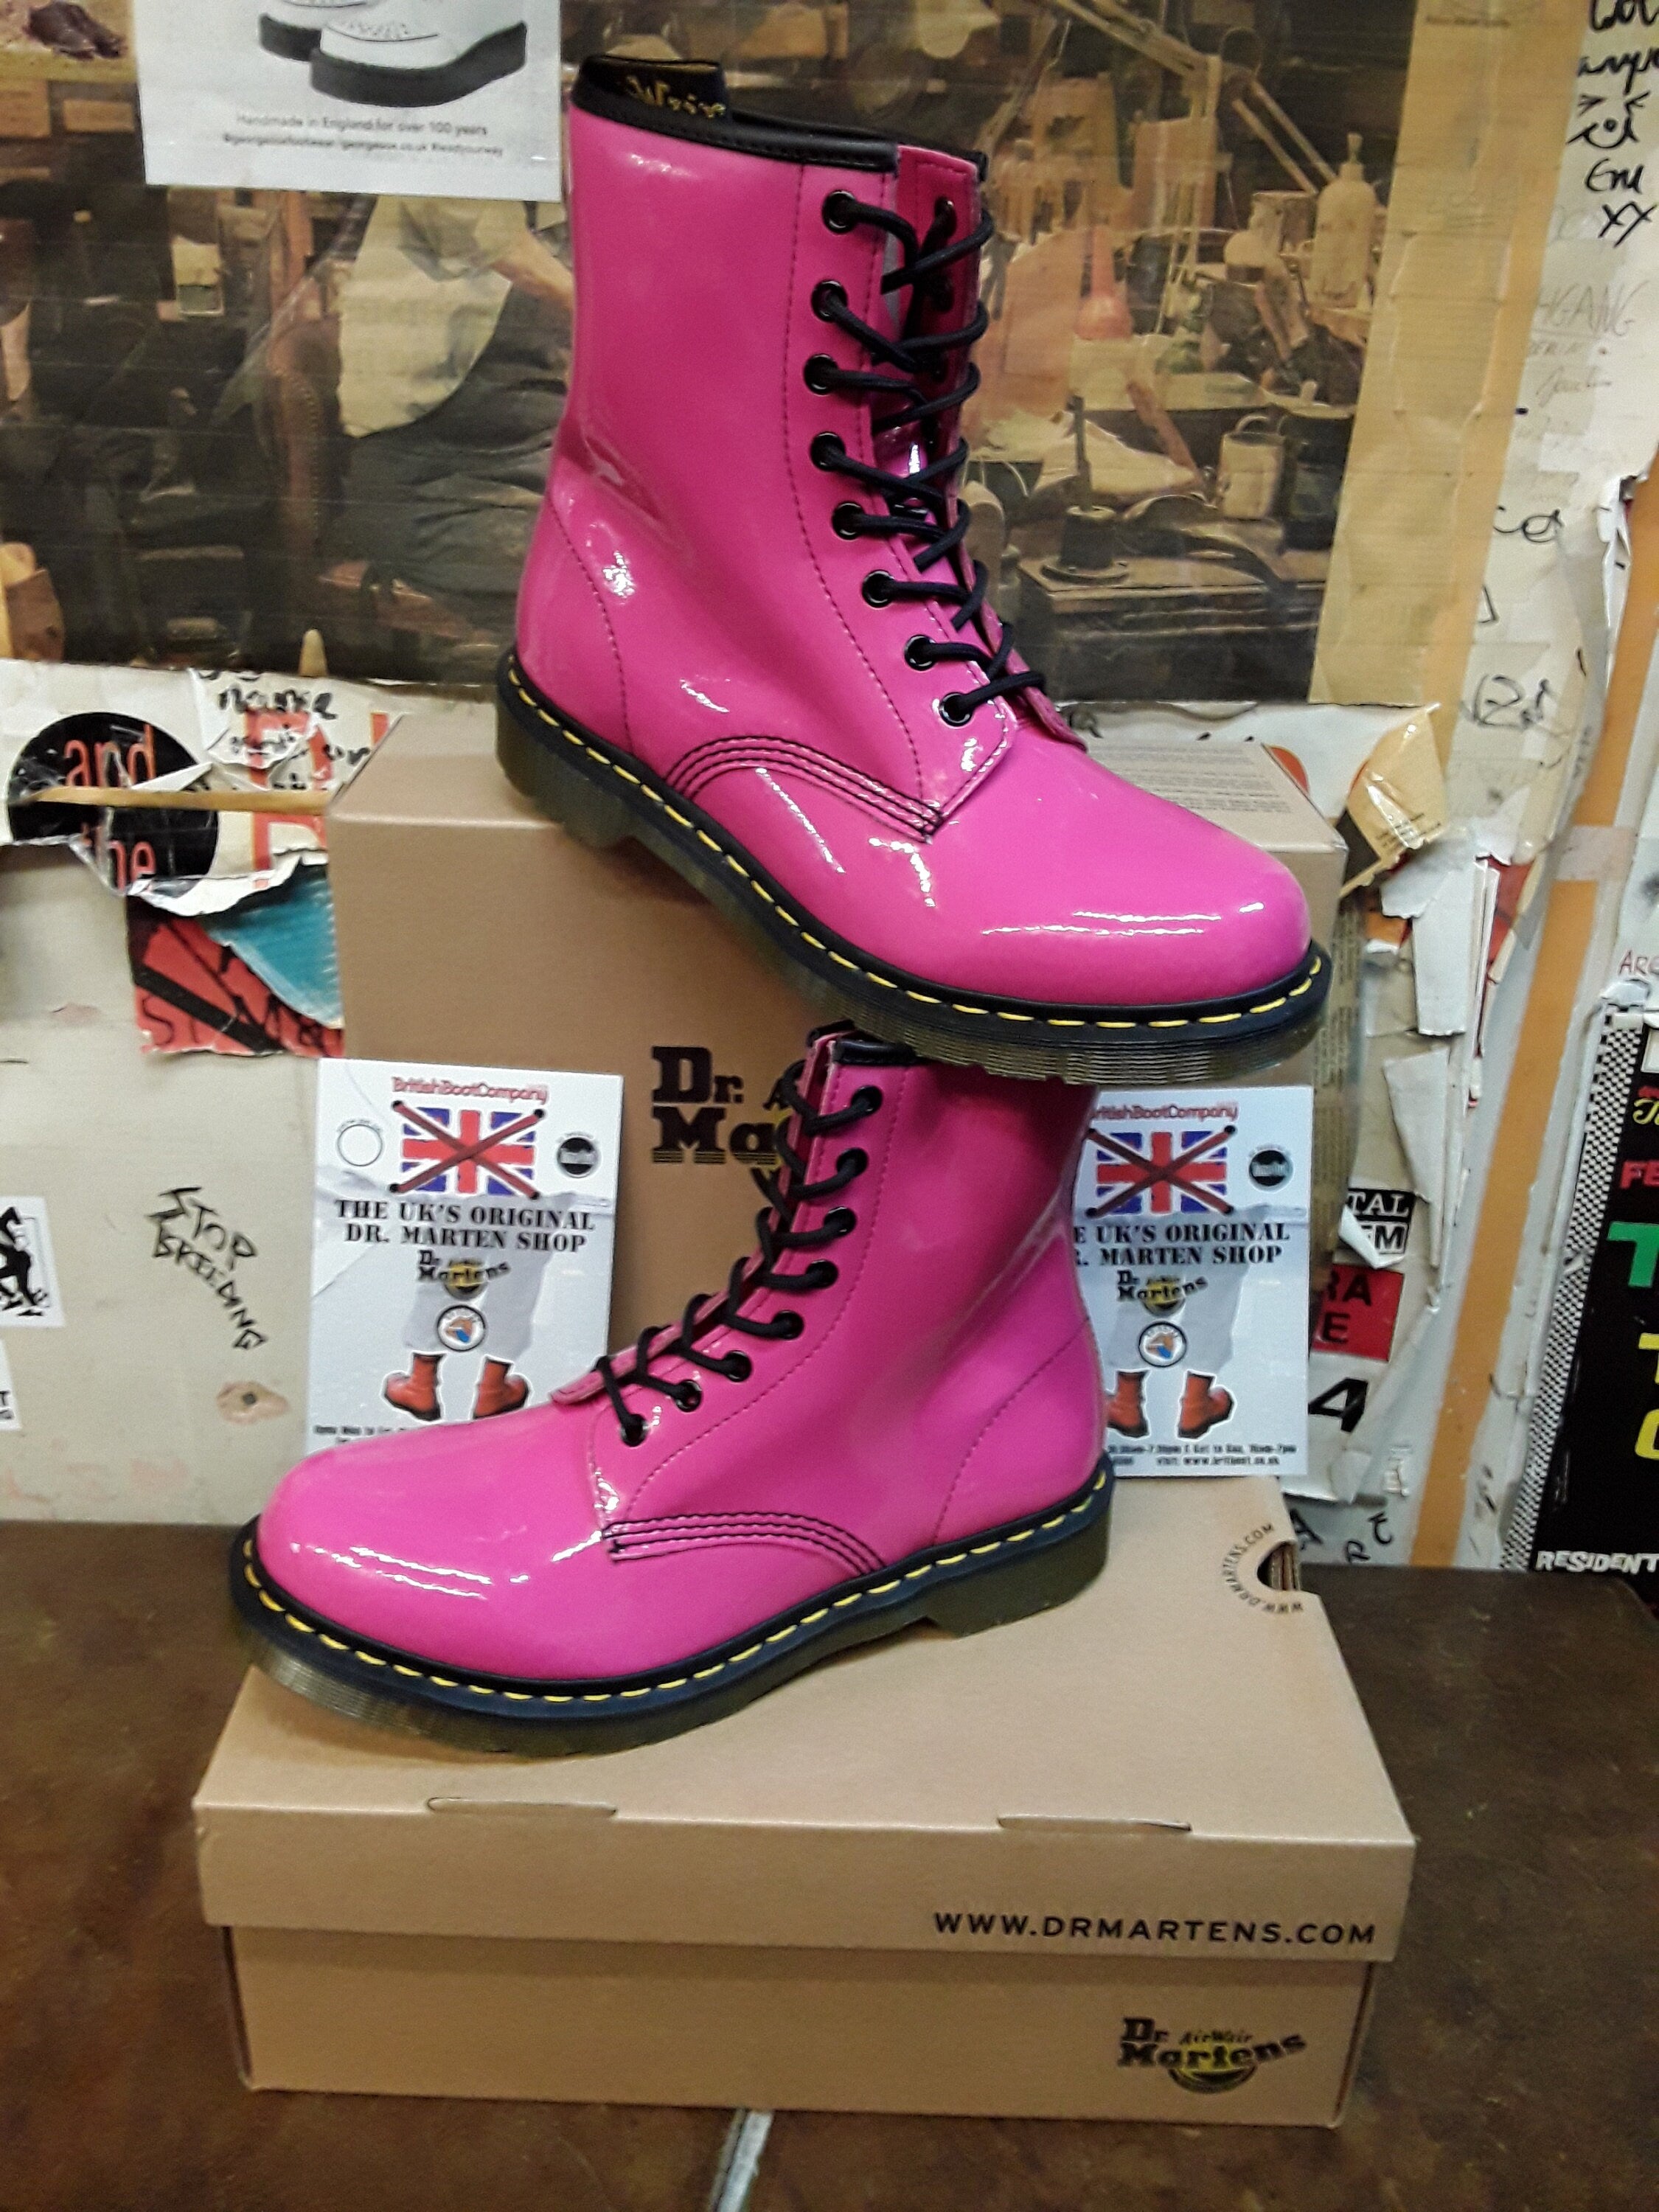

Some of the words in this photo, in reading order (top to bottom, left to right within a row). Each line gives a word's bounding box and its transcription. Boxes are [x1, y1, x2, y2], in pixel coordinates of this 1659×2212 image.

[63, 720, 157, 787] and
[652, 1046, 743, 1103] Dr.
[335, 1200, 389, 1220] THE
[399, 1203, 462, 1222] UK'S
[470, 1207, 596, 1231] ORIGINAL
[346, 1223, 390, 1244] DR.
[401, 1227, 508, 1249] MARTEN
[518, 1232, 587, 1253] SHOP
[1096, 1224, 1156, 1244] UK'S
[1165, 1223, 1290, 1242] ORIGINAL
[1099, 1246, 1203, 1266] MARTEN
[1213, 1245, 1283, 1265] SHOP
[417, 1261, 510, 1282] Martens
[1117, 1276, 1208, 1301] Martens
[933, 1912, 1376, 1945] WWW.DRMARTENS.COM
[1117, 2034, 1307, 2067] Martens
